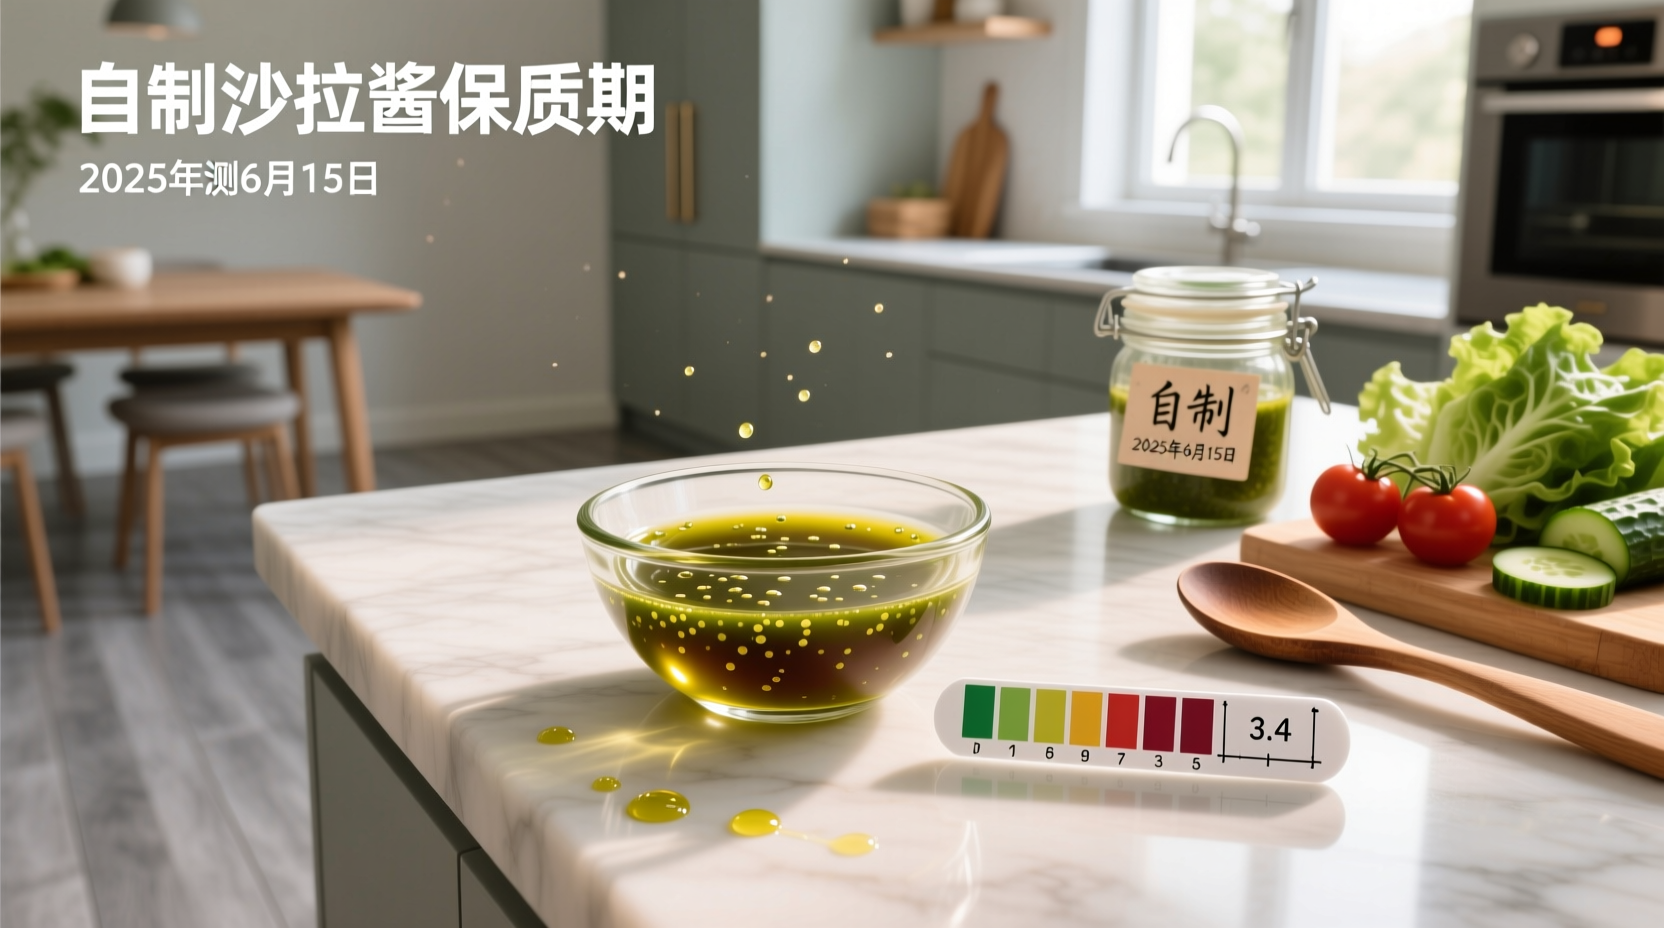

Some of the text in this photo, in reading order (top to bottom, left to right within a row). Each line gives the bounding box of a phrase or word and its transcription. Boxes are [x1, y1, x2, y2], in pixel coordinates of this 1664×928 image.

[1151, 380, 1235, 437] 自制
[1131, 437, 1236, 463] 2025年6月15日
[1249, 716, 1292, 743] 3.4
[1008, 743, 1016, 758] 1
[1045, 746, 1055, 760] 6
[1080, 749, 1090, 763] 9
[1117, 752, 1126, 766] 7
[1154, 754, 1164, 768] 3
[1191, 756, 1201, 771] 5
